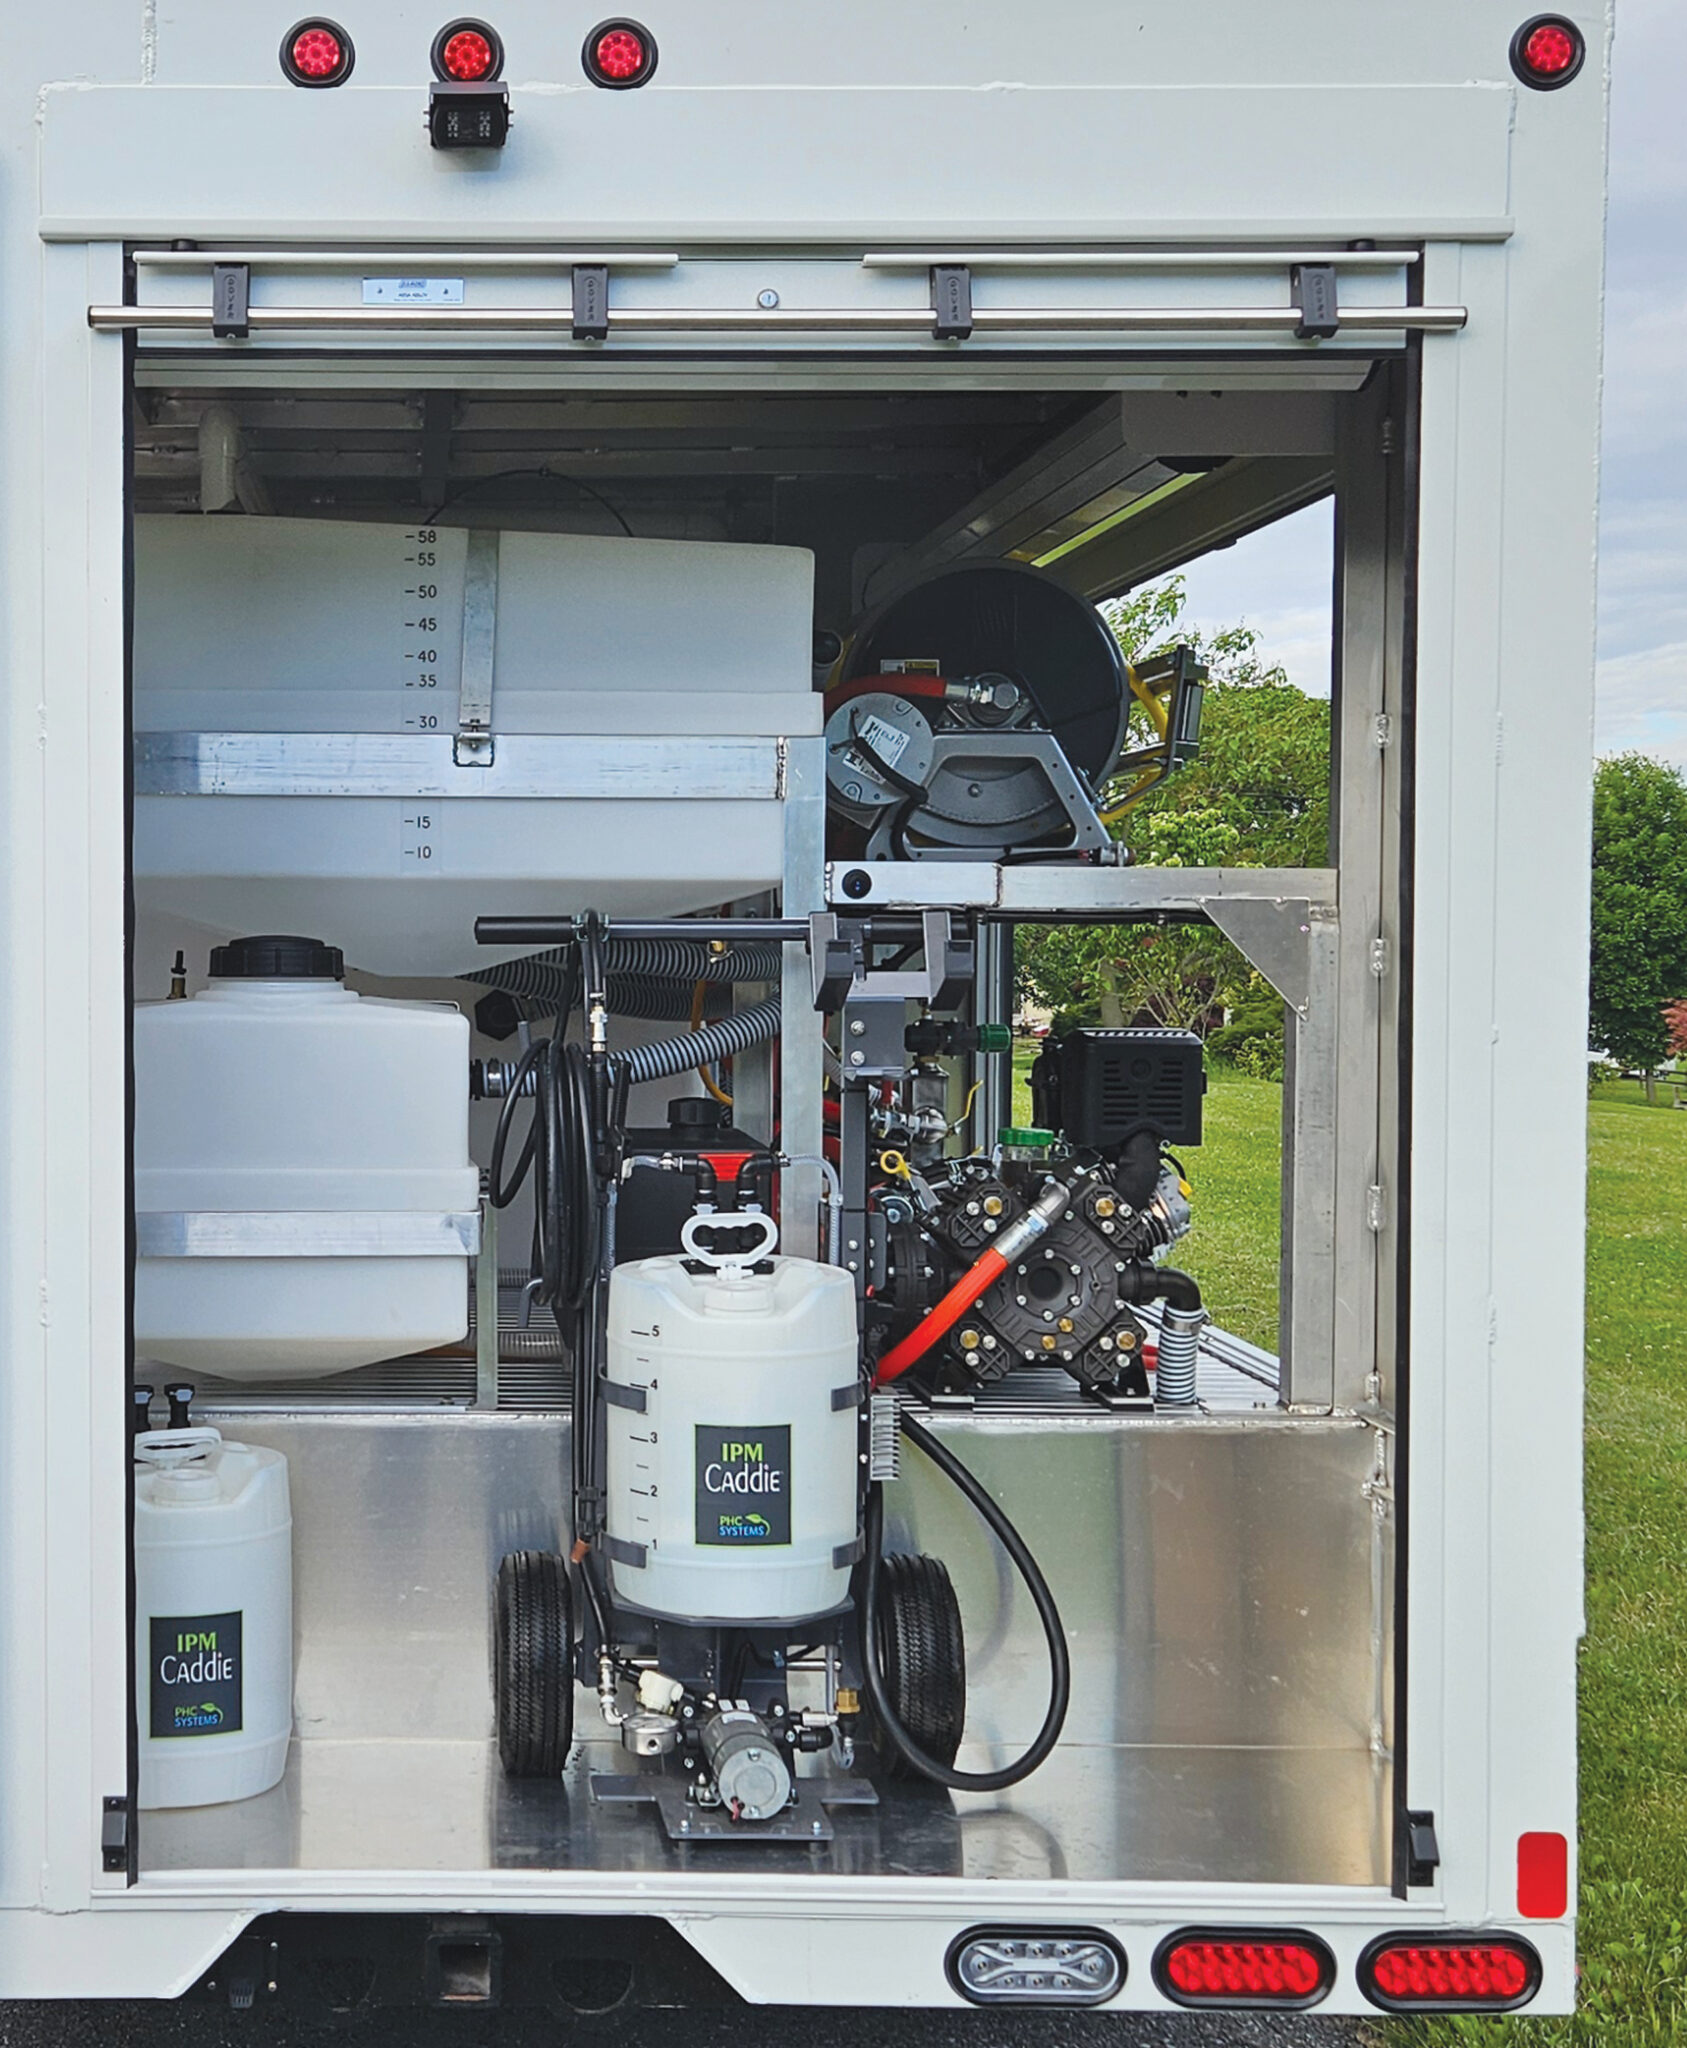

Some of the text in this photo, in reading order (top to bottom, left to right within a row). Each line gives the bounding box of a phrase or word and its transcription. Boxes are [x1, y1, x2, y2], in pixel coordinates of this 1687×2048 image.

[418, 530, 437, 543] 58
[418, 553, 436, 566] 55
[418, 585, 437, 598] 50
[418, 617, 437, 631] 45
[418, 650, 437, 663] 40
[418, 674, 437, 688] 35
[419, 715, 437, 728] 30
[417, 816, 431, 829] 15
[417, 846, 432, 859] 10
[651, 1325, 660, 1337] 5
[650, 1379, 658, 1390] 4
[650, 1432, 658, 1444] 3
[721, 1443, 763, 1462] IPM
[650, 1485, 658, 1497] 2
[719, 1515, 743, 1527] PHC
[719, 1525, 765, 1537] SYSTEMS
[652, 1539, 658, 1550] 1
[177, 1632, 217, 1653] IPM
[174, 1706, 198, 1717] PHC
[174, 1714, 218, 1728] SYSTEMS
